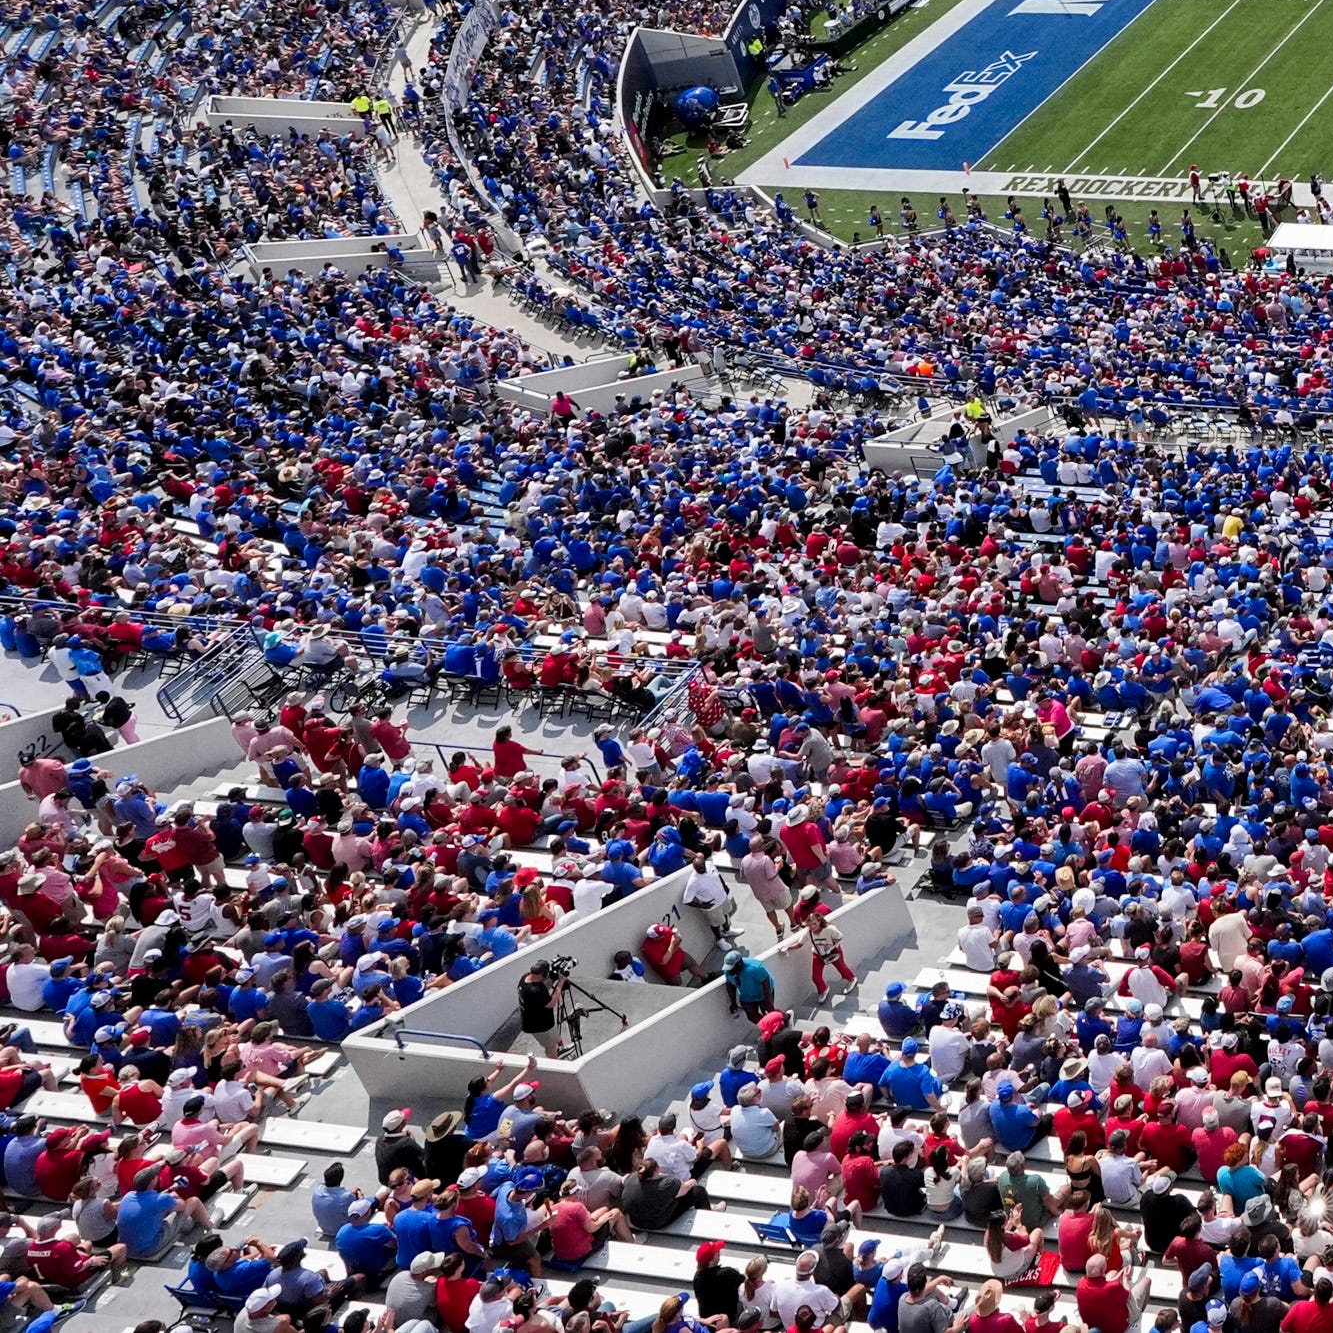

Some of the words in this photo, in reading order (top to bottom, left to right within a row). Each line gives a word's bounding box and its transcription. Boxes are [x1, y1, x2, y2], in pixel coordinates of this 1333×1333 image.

[886, 50, 1038, 141] FedEx
[1195, 87, 1267, 109] 10
[1001, 176, 1060, 193] REX
[1066, 178, 1193, 197] DOCKERY
[180, 905, 193, 921] 5
